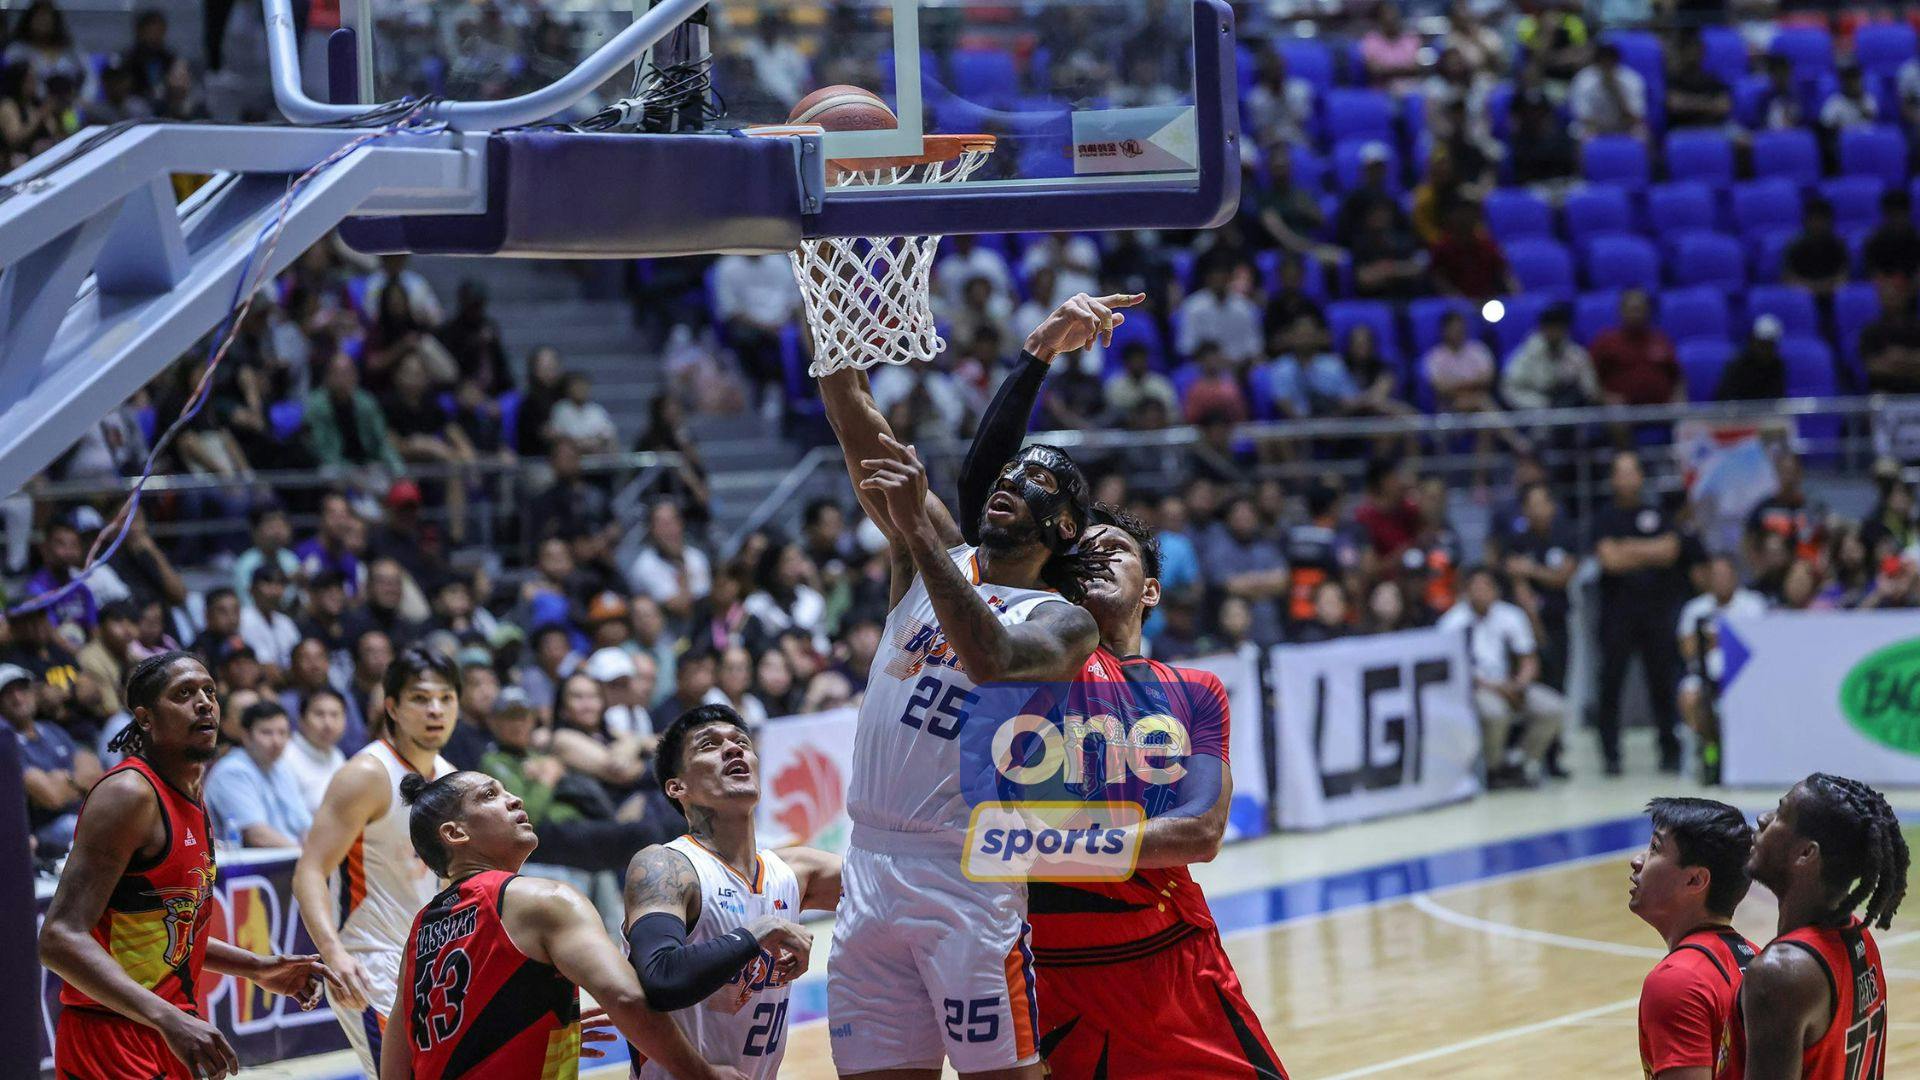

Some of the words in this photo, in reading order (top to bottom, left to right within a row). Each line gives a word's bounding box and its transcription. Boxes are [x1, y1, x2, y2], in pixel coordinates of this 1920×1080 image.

[901, 675, 980, 741] 25
[415, 947, 471, 1052] 13
[742, 998, 789, 1057] 20
[943, 997, 1000, 1043] 25
